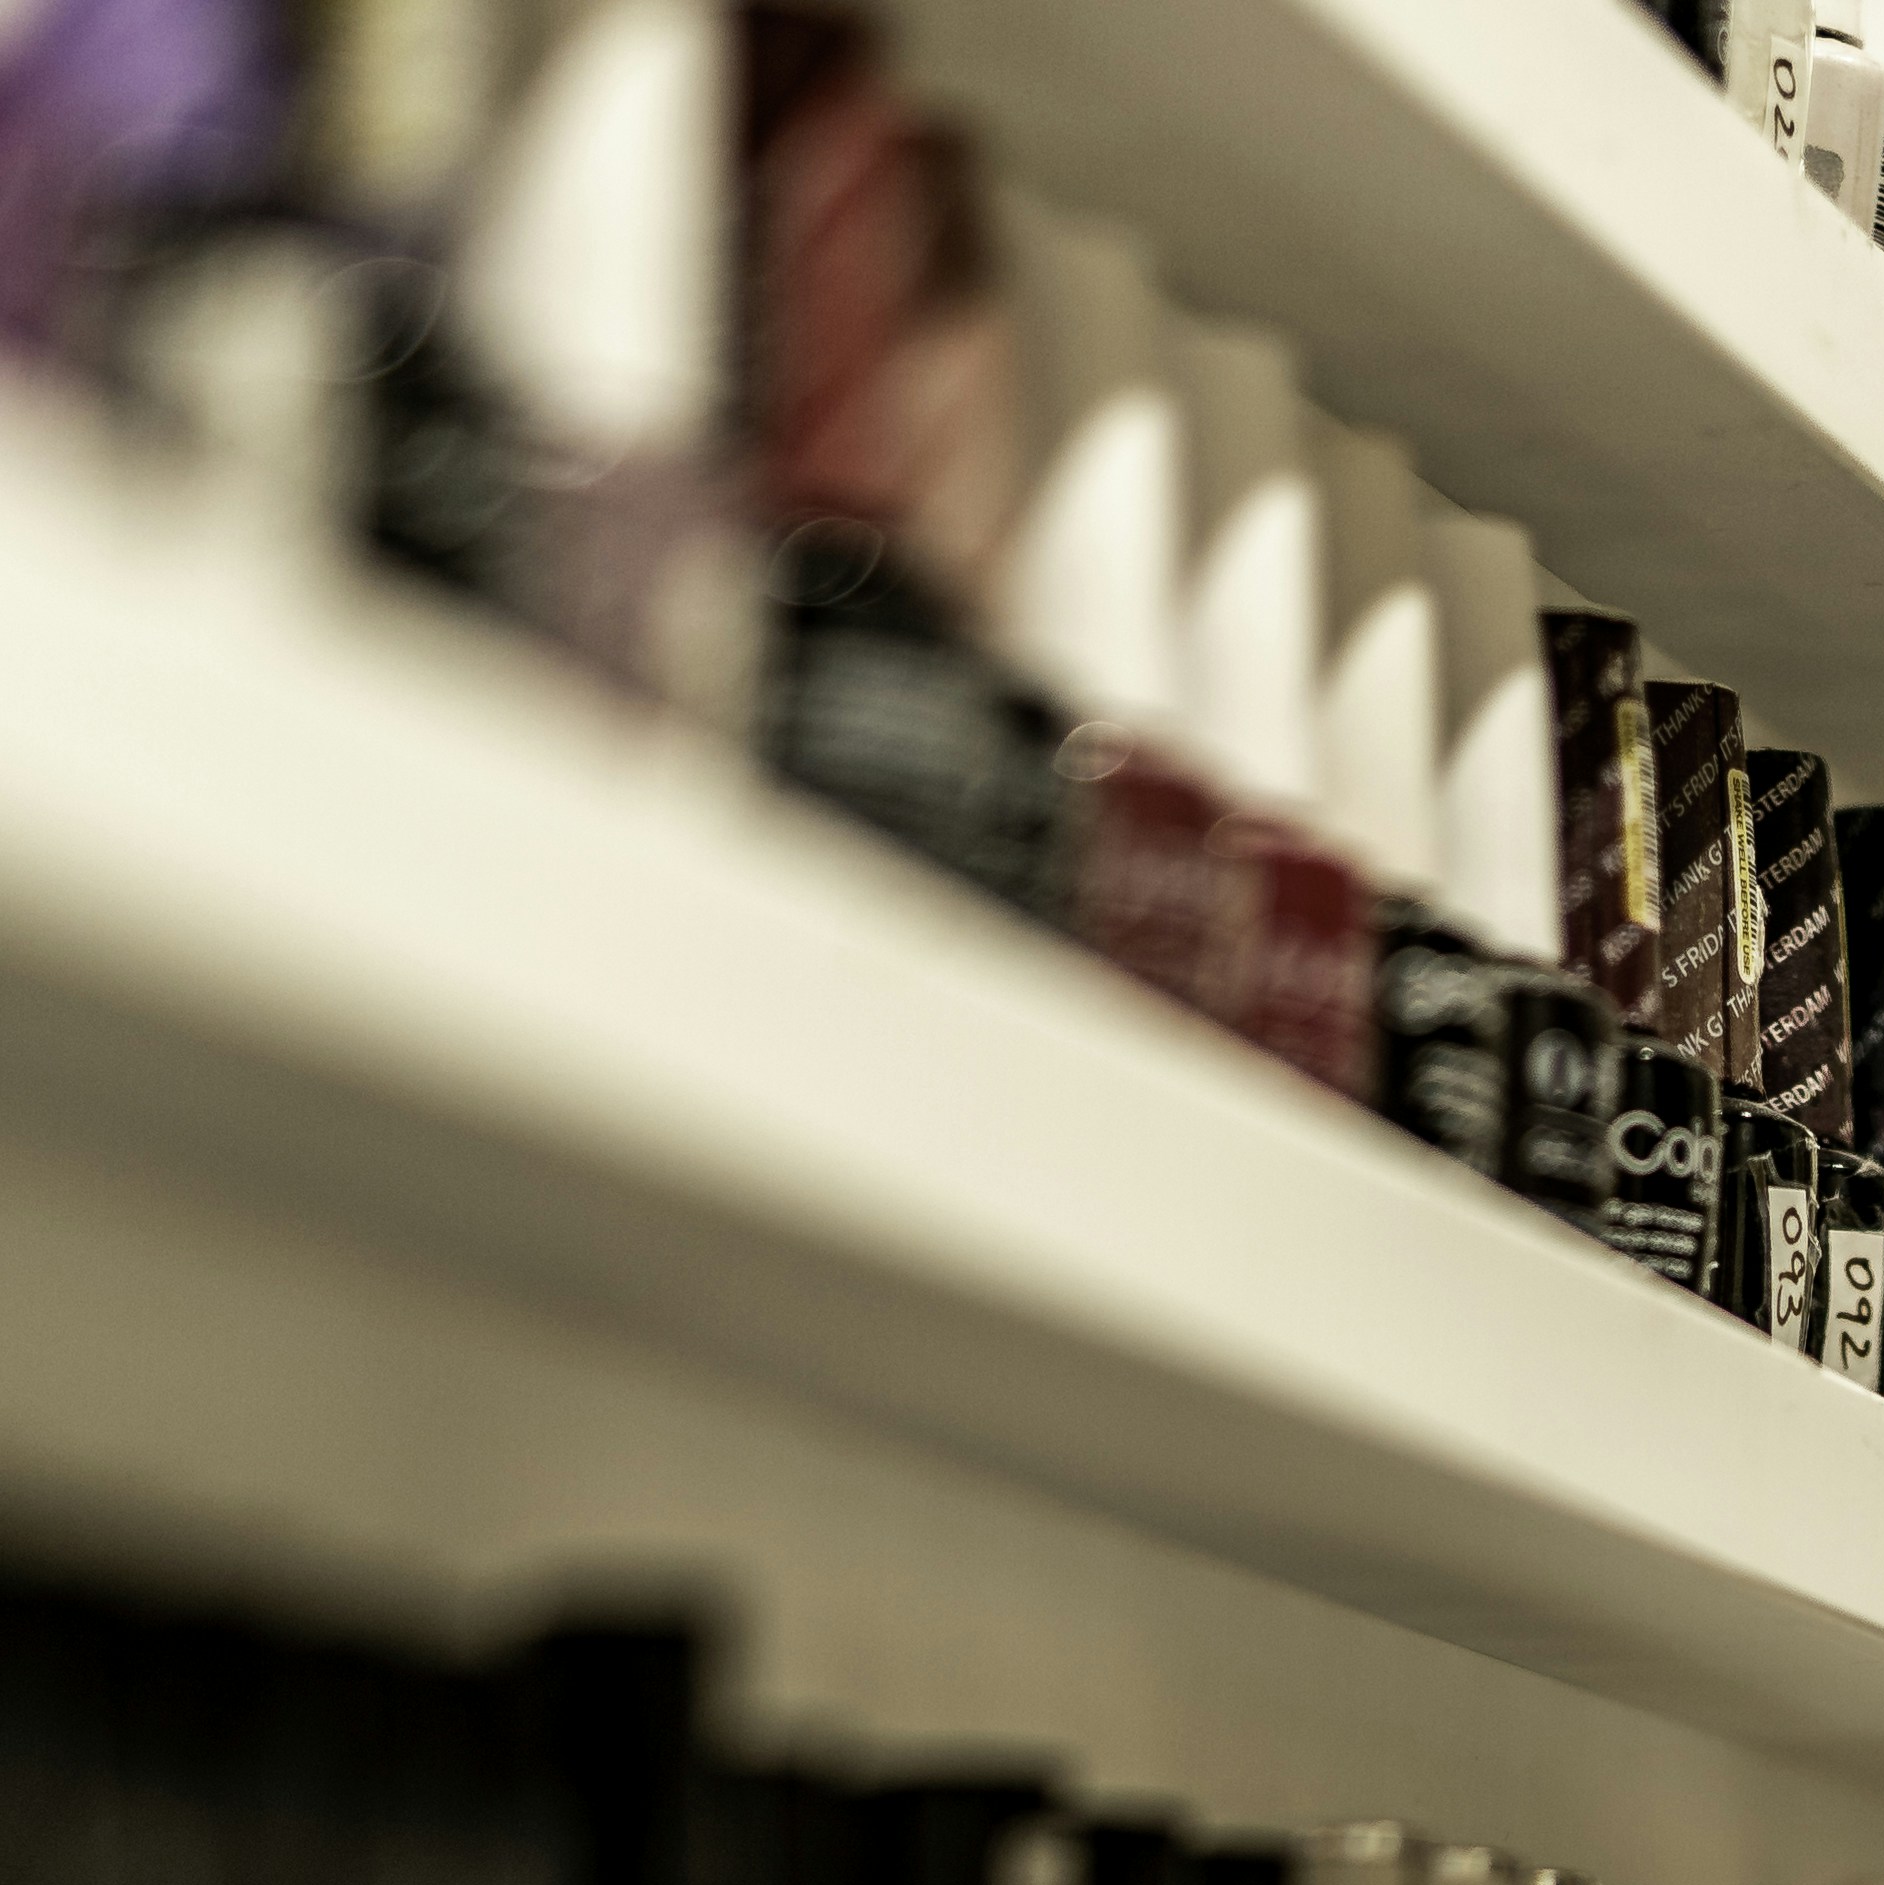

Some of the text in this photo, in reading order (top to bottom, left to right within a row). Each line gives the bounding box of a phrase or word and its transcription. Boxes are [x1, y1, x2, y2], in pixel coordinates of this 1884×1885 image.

[1773, 57, 1797, 161] 02
[1652, 687, 1705, 747] THANK
[1732, 776, 1751, 977] SHAKE WELL BEFORE USE
[1777, 1206, 1807, 1327] 093
[1835, 1257, 1875, 1370] 092
